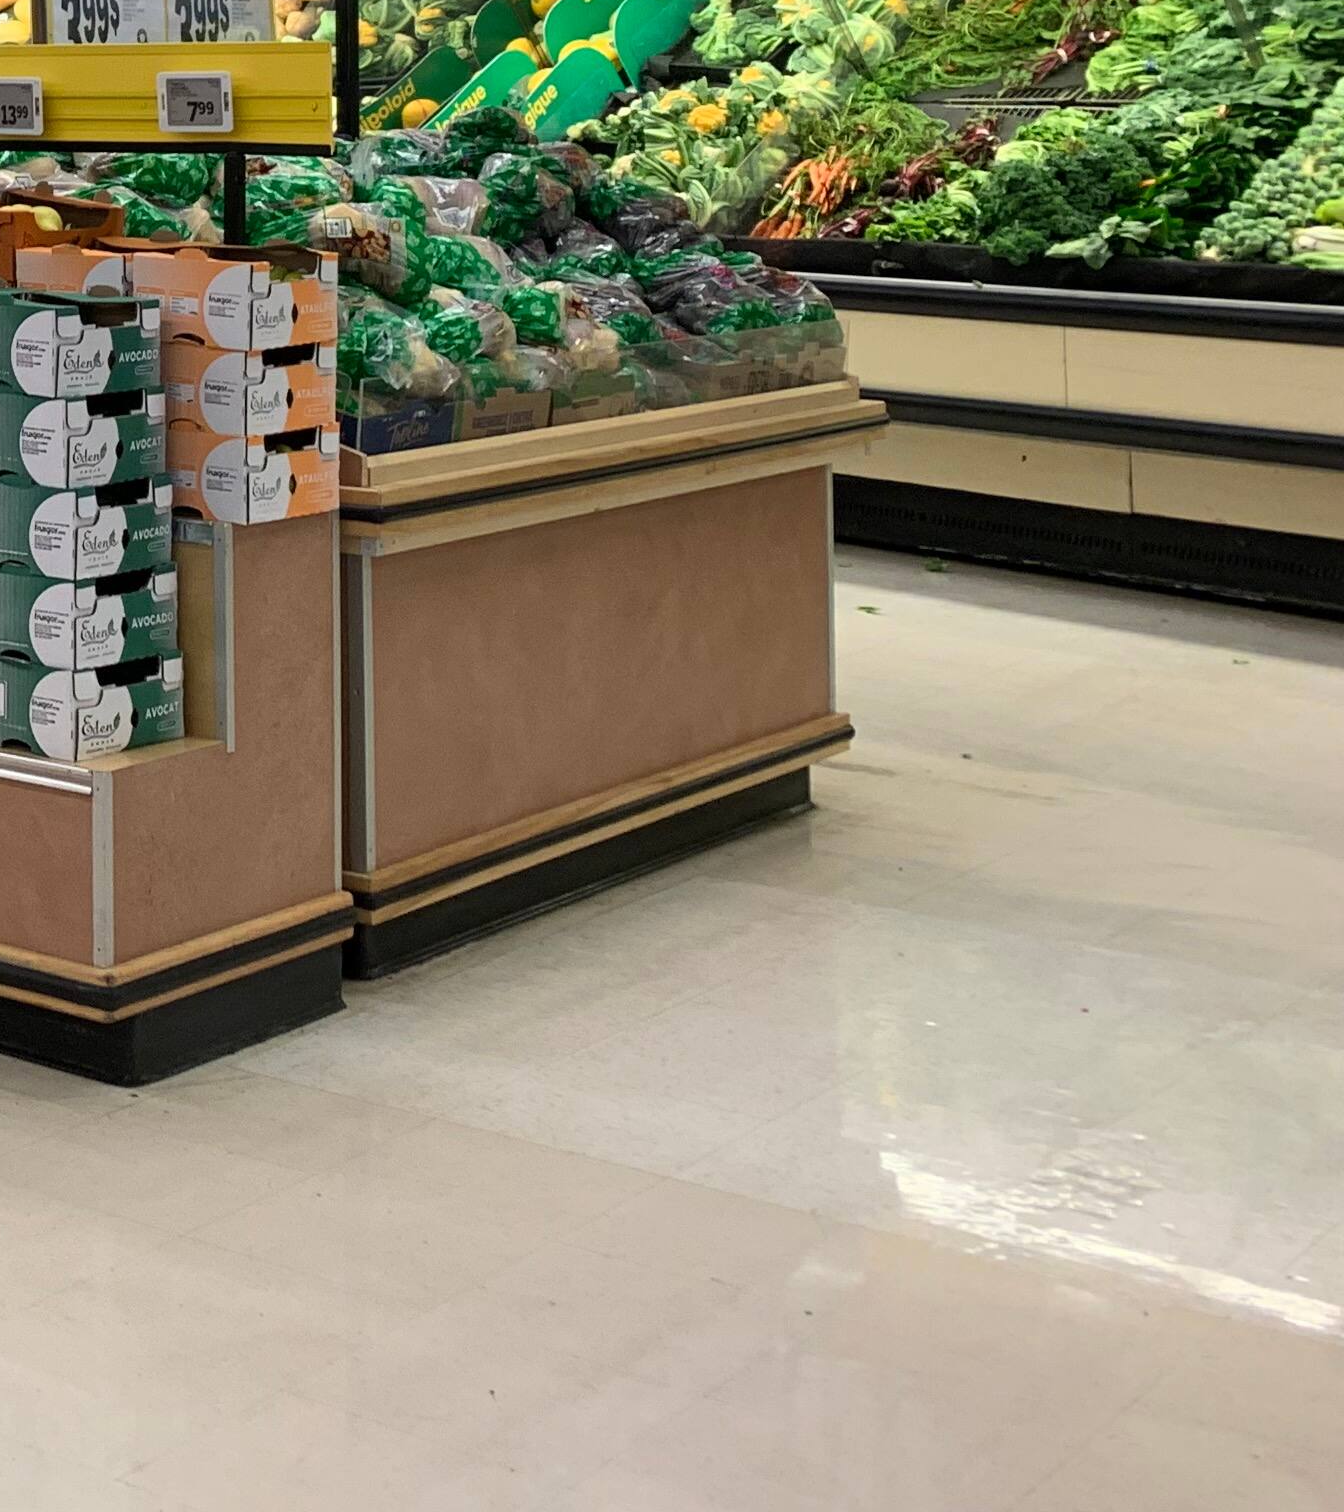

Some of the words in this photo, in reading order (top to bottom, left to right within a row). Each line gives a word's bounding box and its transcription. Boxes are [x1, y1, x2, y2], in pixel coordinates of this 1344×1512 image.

[118, 349, 159, 364] AVOCADO
[129, 437, 162, 452] AVOCAT
[132, 525, 170, 542] AVOCADO
[131, 611, 175, 630] AVOCADO
[144, 701, 180, 721] AVOCAT
